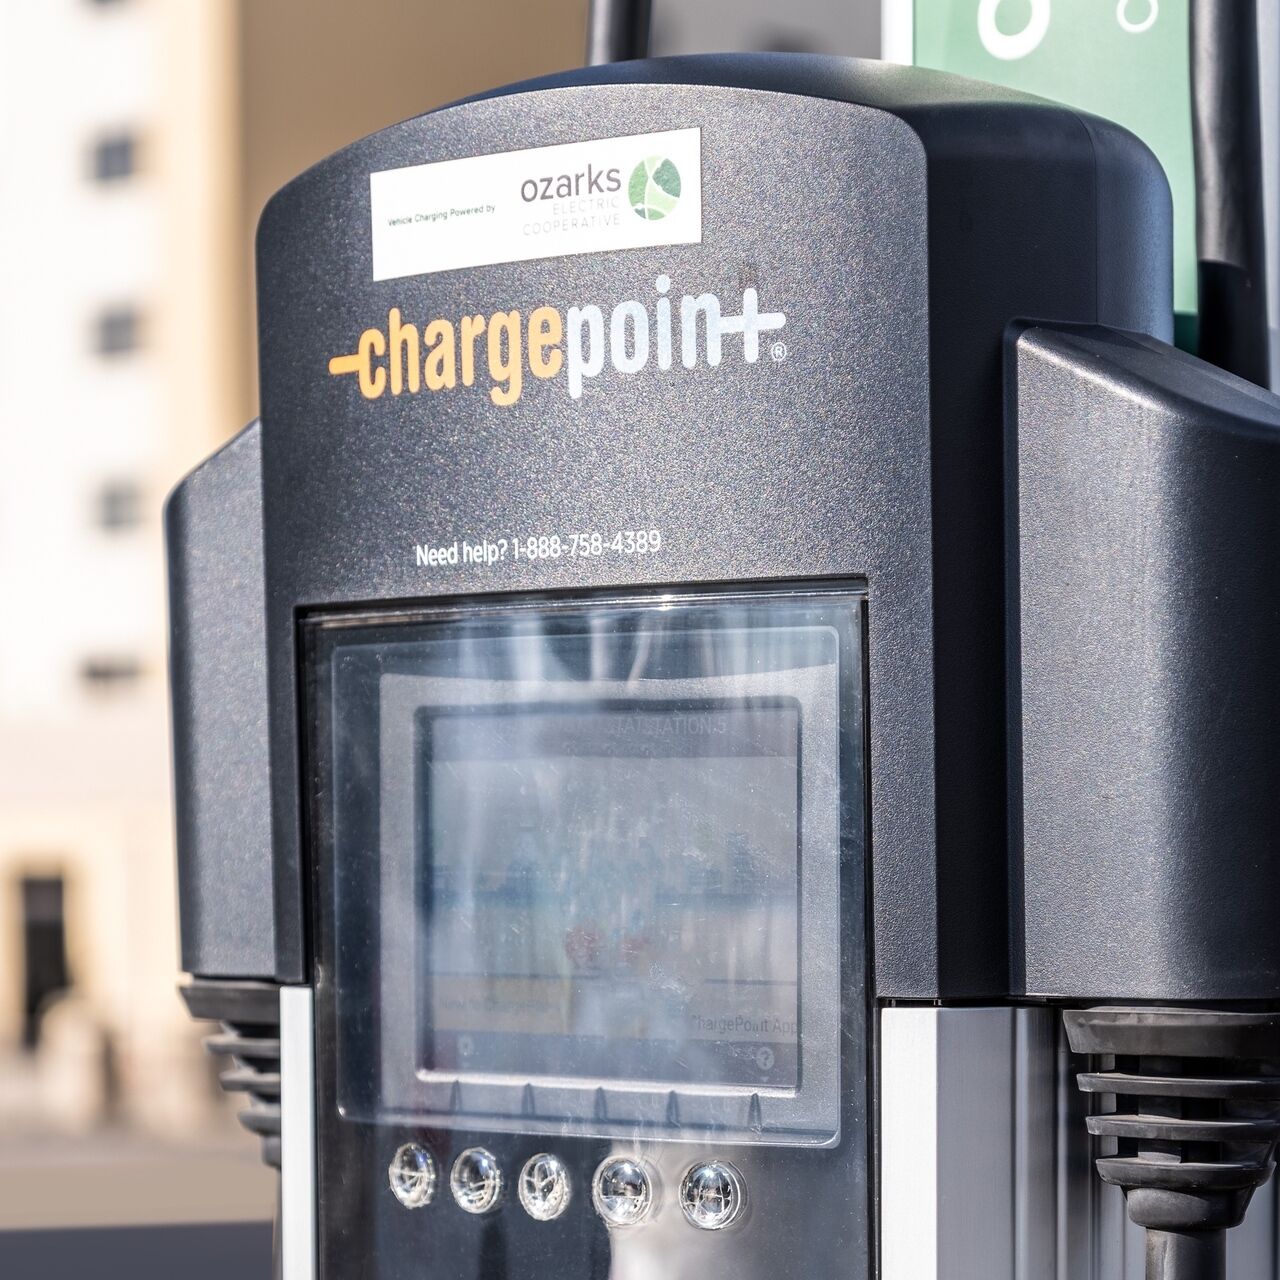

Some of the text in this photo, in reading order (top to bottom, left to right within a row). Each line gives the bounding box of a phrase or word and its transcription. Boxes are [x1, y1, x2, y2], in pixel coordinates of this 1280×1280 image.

[521, 164, 621, 202] ozarks
[387, 204, 496, 226] Vehicle Charging Powered by
[553, 197, 620, 215] ELECTRIC
[523, 214, 620, 236] COOPERATIVE
[416, 530, 662, 566] Need help? 1-888-758-4389
